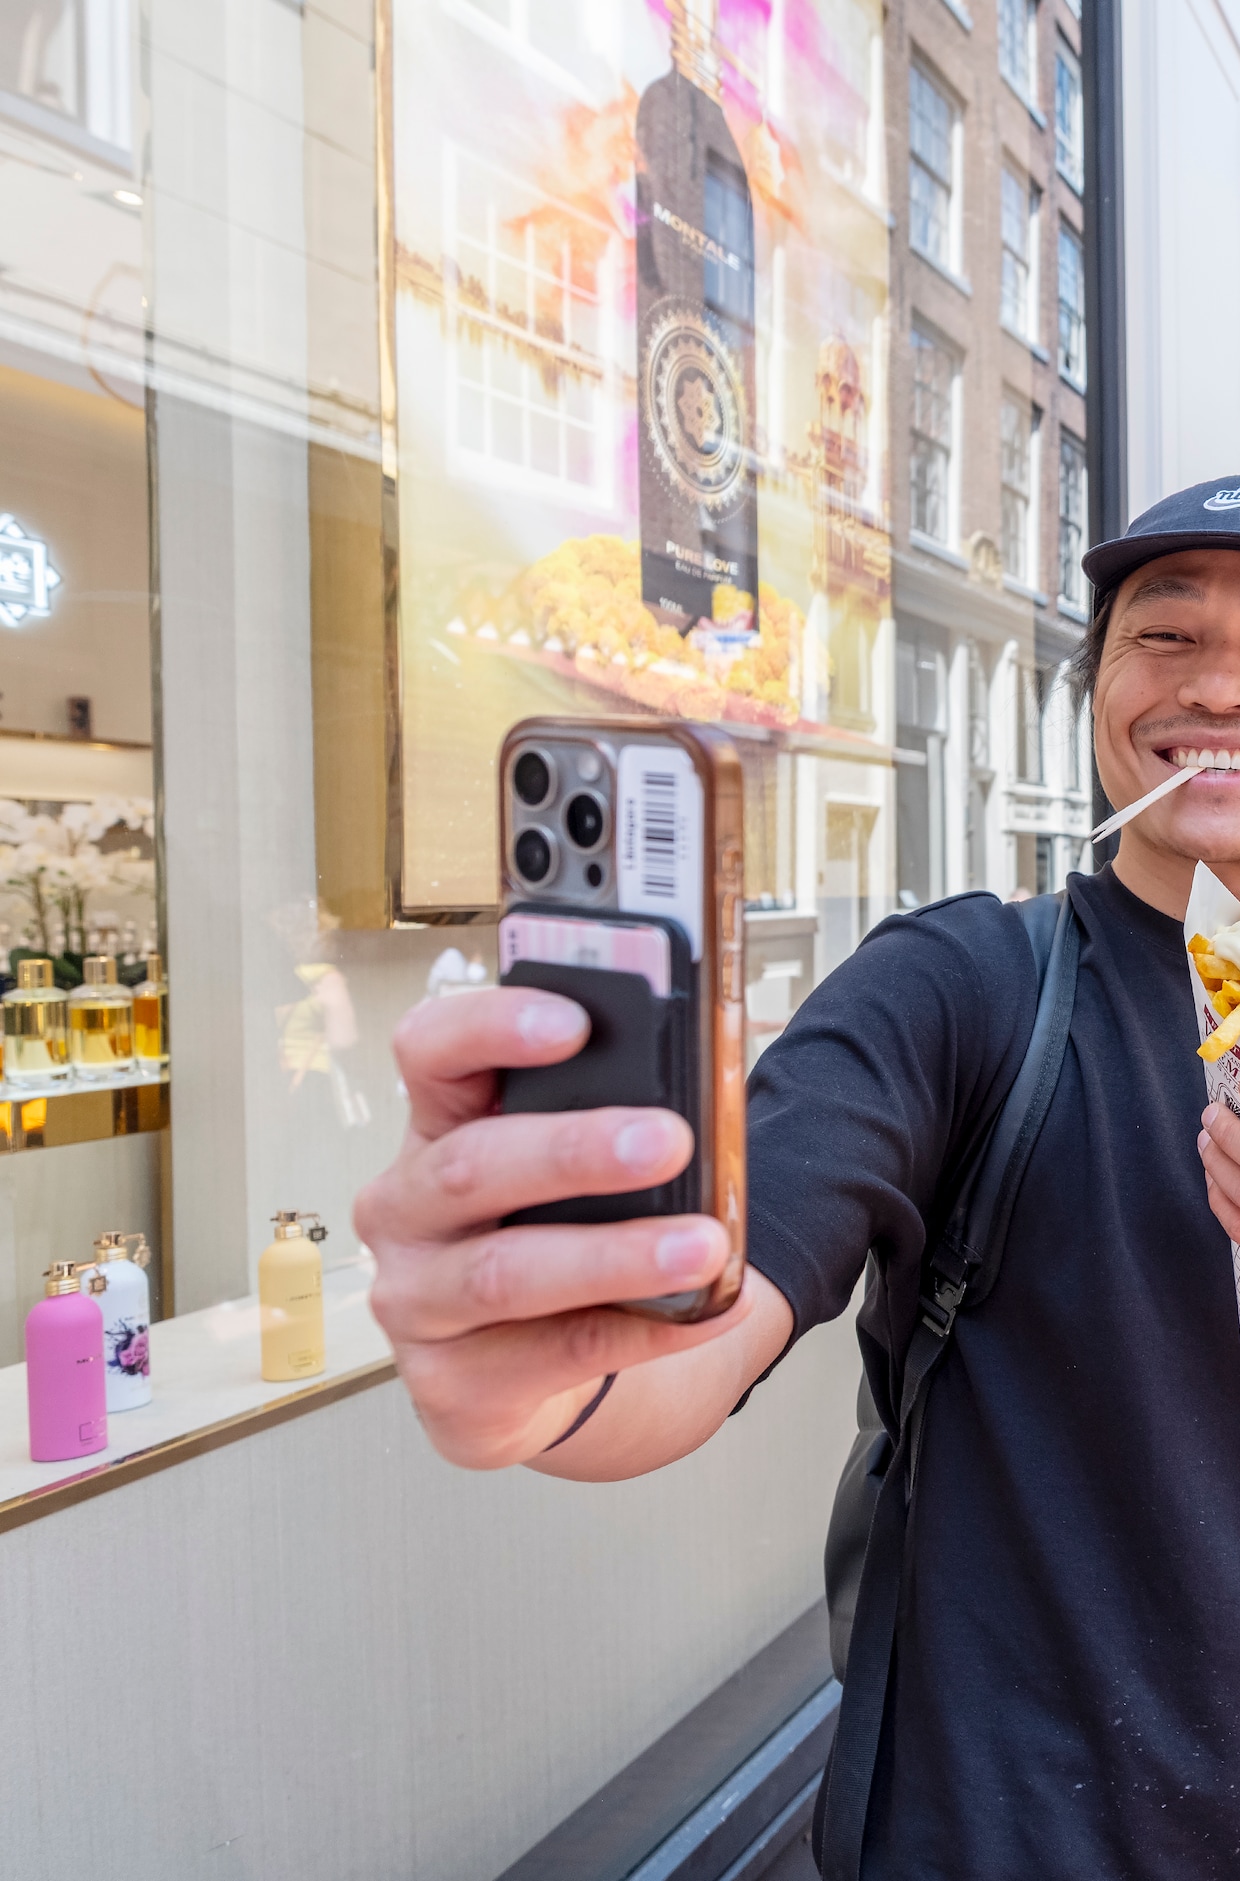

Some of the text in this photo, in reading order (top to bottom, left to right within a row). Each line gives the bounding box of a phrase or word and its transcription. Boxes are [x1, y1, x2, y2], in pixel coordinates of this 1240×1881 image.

[653, 201, 740, 271] MONTALE
[666, 540, 738, 576] PURE LOVE
